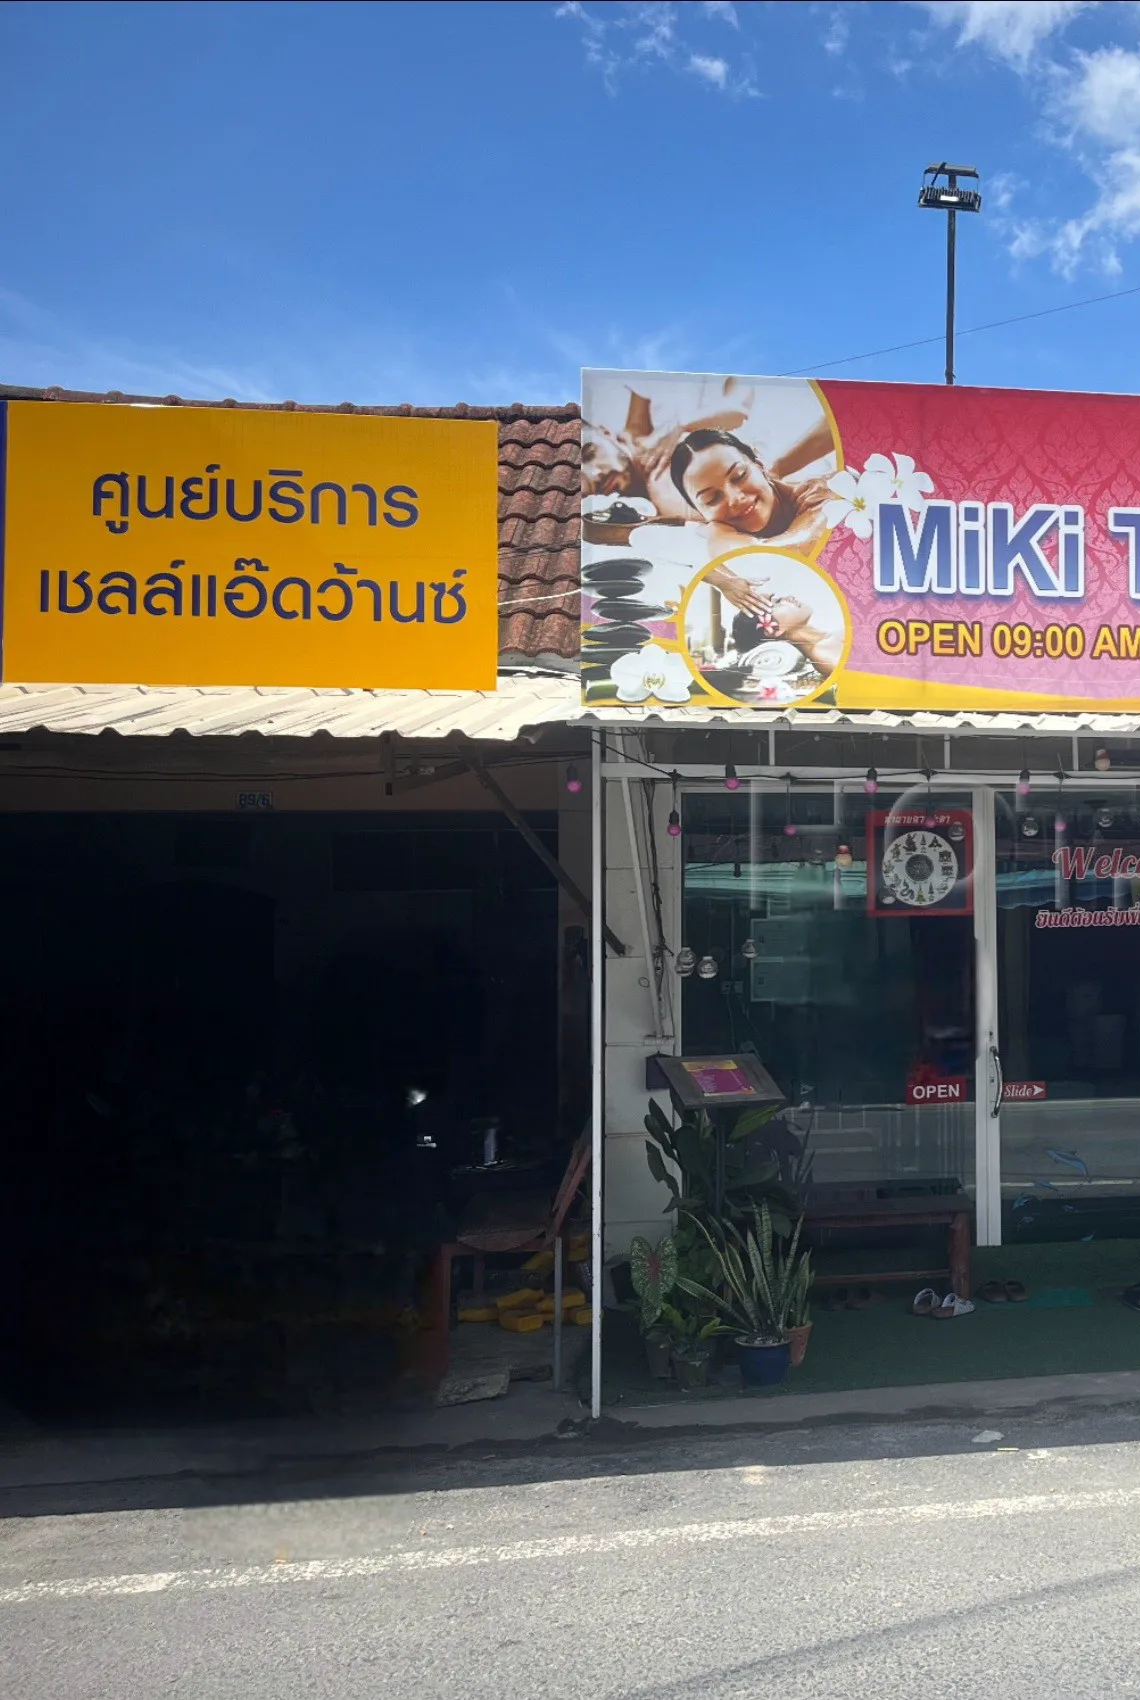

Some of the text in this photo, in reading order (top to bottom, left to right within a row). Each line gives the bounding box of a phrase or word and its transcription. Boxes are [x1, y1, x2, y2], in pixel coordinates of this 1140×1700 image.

[91, 463, 420, 534] ศูนย์บริการ
[874, 500, 1084, 597] MiKi
[39, 557, 468, 624] เชลล์แอ๊ดว้านซ์
[877, 621, 983, 659] OPEN
[991, 623, 1084, 660] 09:00
[912, 1084, 960, 1100] OPEN
[1003, 1084, 1033, 1098] Slide
